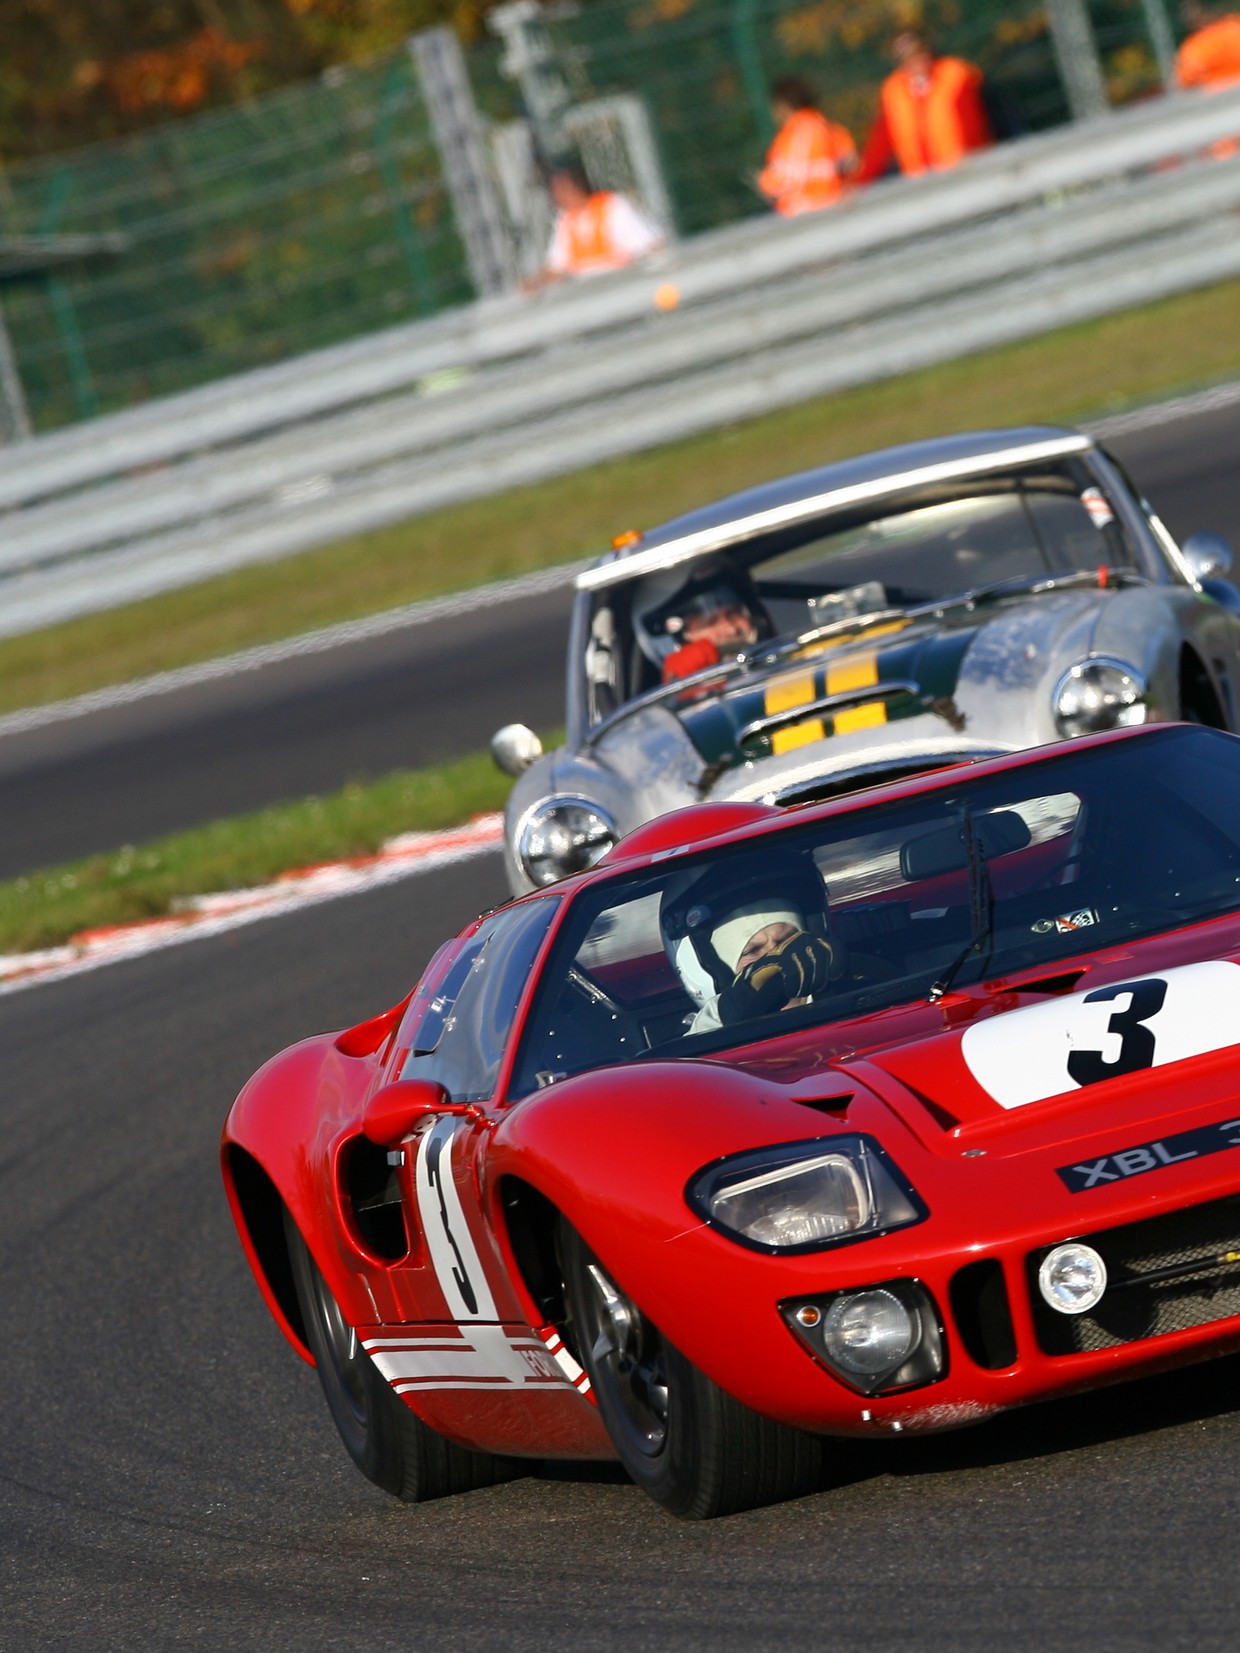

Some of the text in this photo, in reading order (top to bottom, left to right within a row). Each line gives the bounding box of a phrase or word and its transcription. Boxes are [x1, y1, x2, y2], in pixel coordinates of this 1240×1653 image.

[1067, 978, 1168, 1087] 3
[1072, 1143, 1198, 1187] XBL
[427, 1138, 478, 1314] 3
